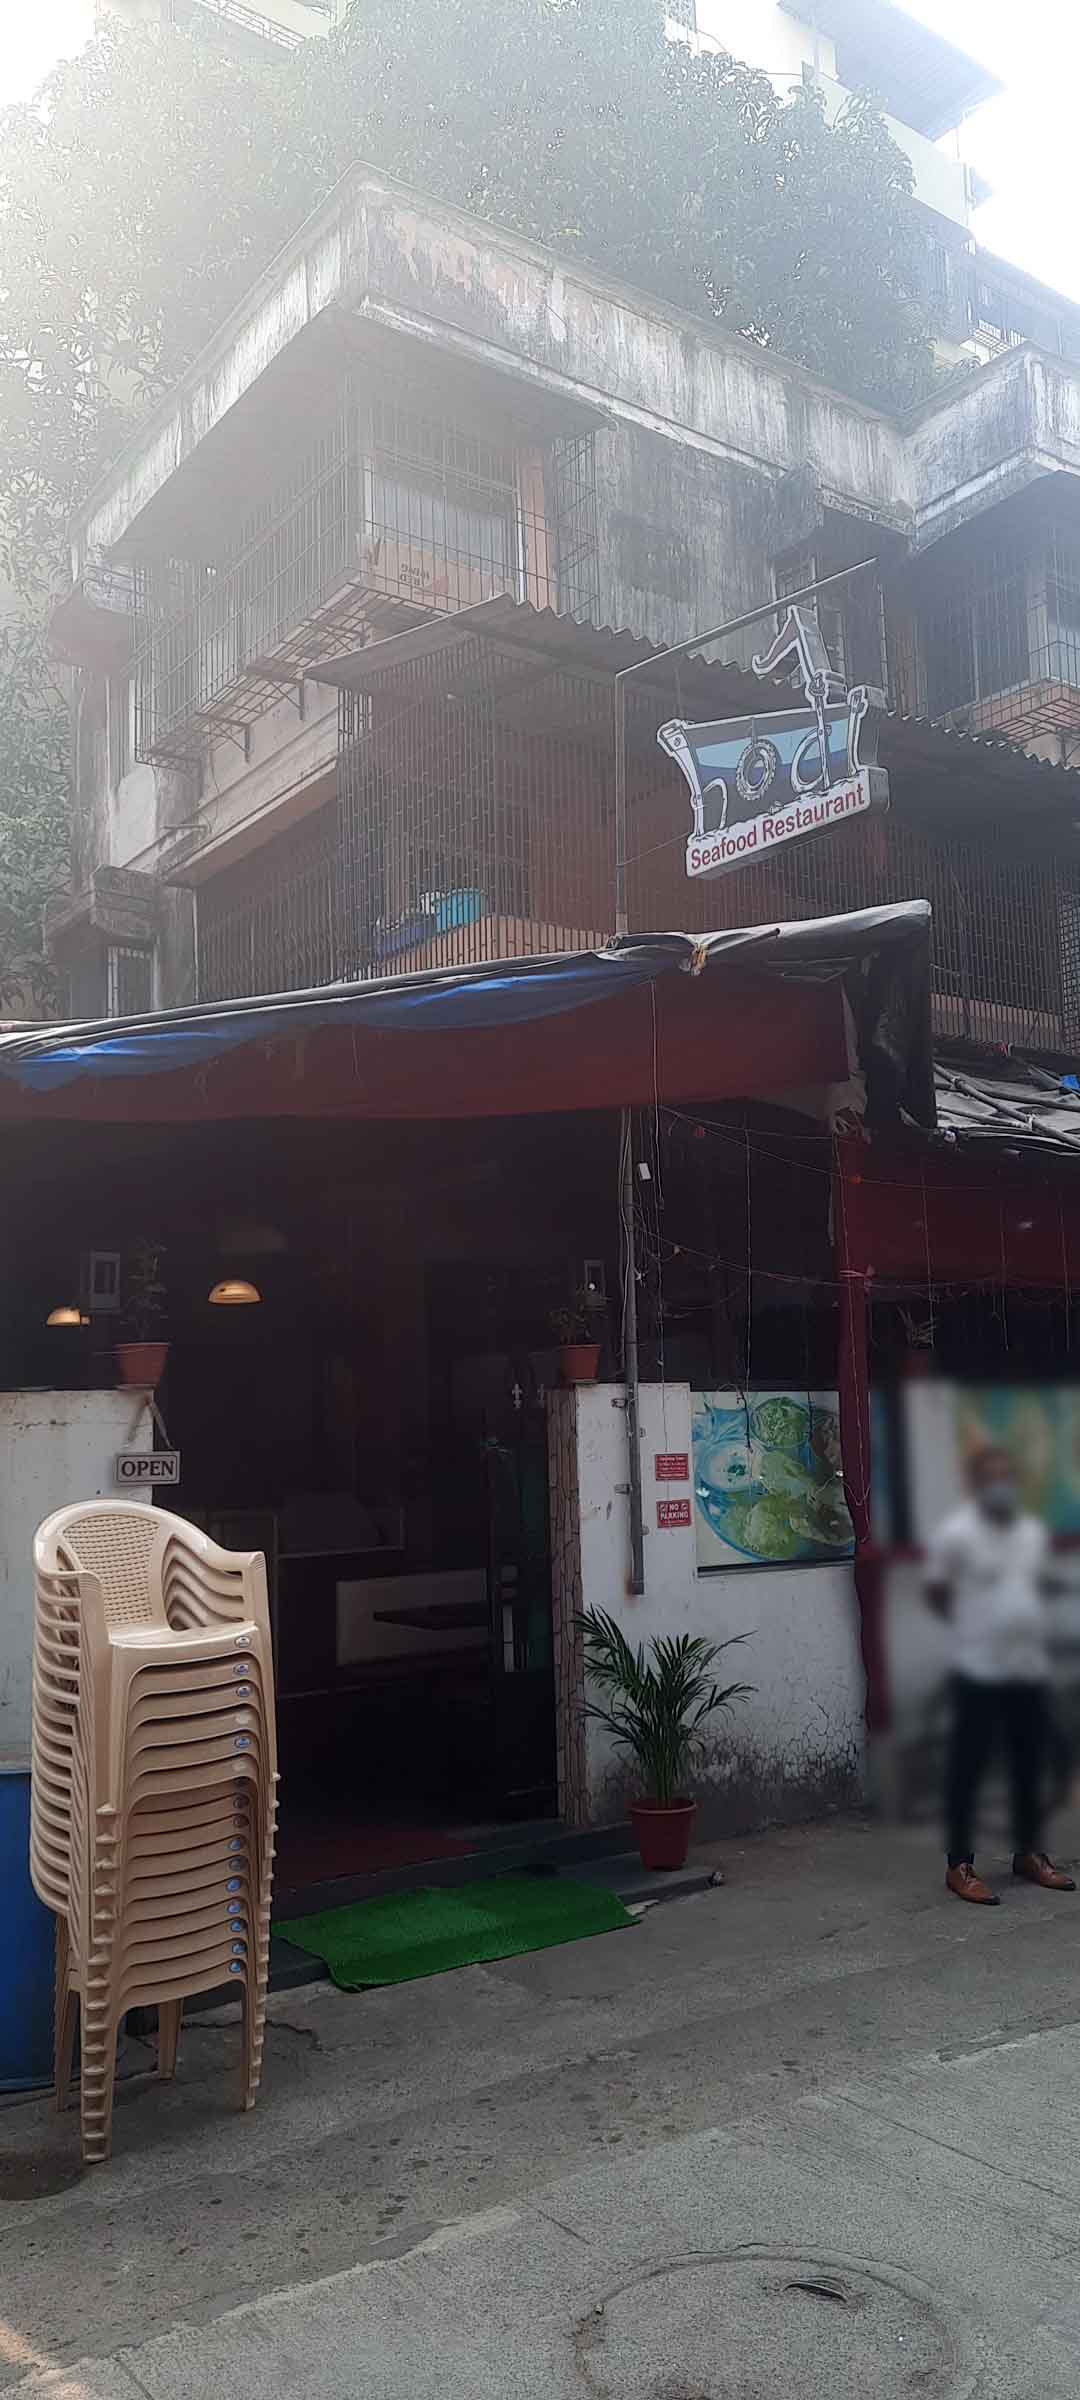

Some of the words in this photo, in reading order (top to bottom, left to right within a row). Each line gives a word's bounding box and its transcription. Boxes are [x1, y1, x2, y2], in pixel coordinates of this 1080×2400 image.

[690, 825, 758, 869] Seafood
[761, 783, 866, 842] Restaurant
[121, 1460, 174, 1477] OPEN
[669, 1503, 680, 1511] NO
[660, 1511, 689, 1521] PARKING
